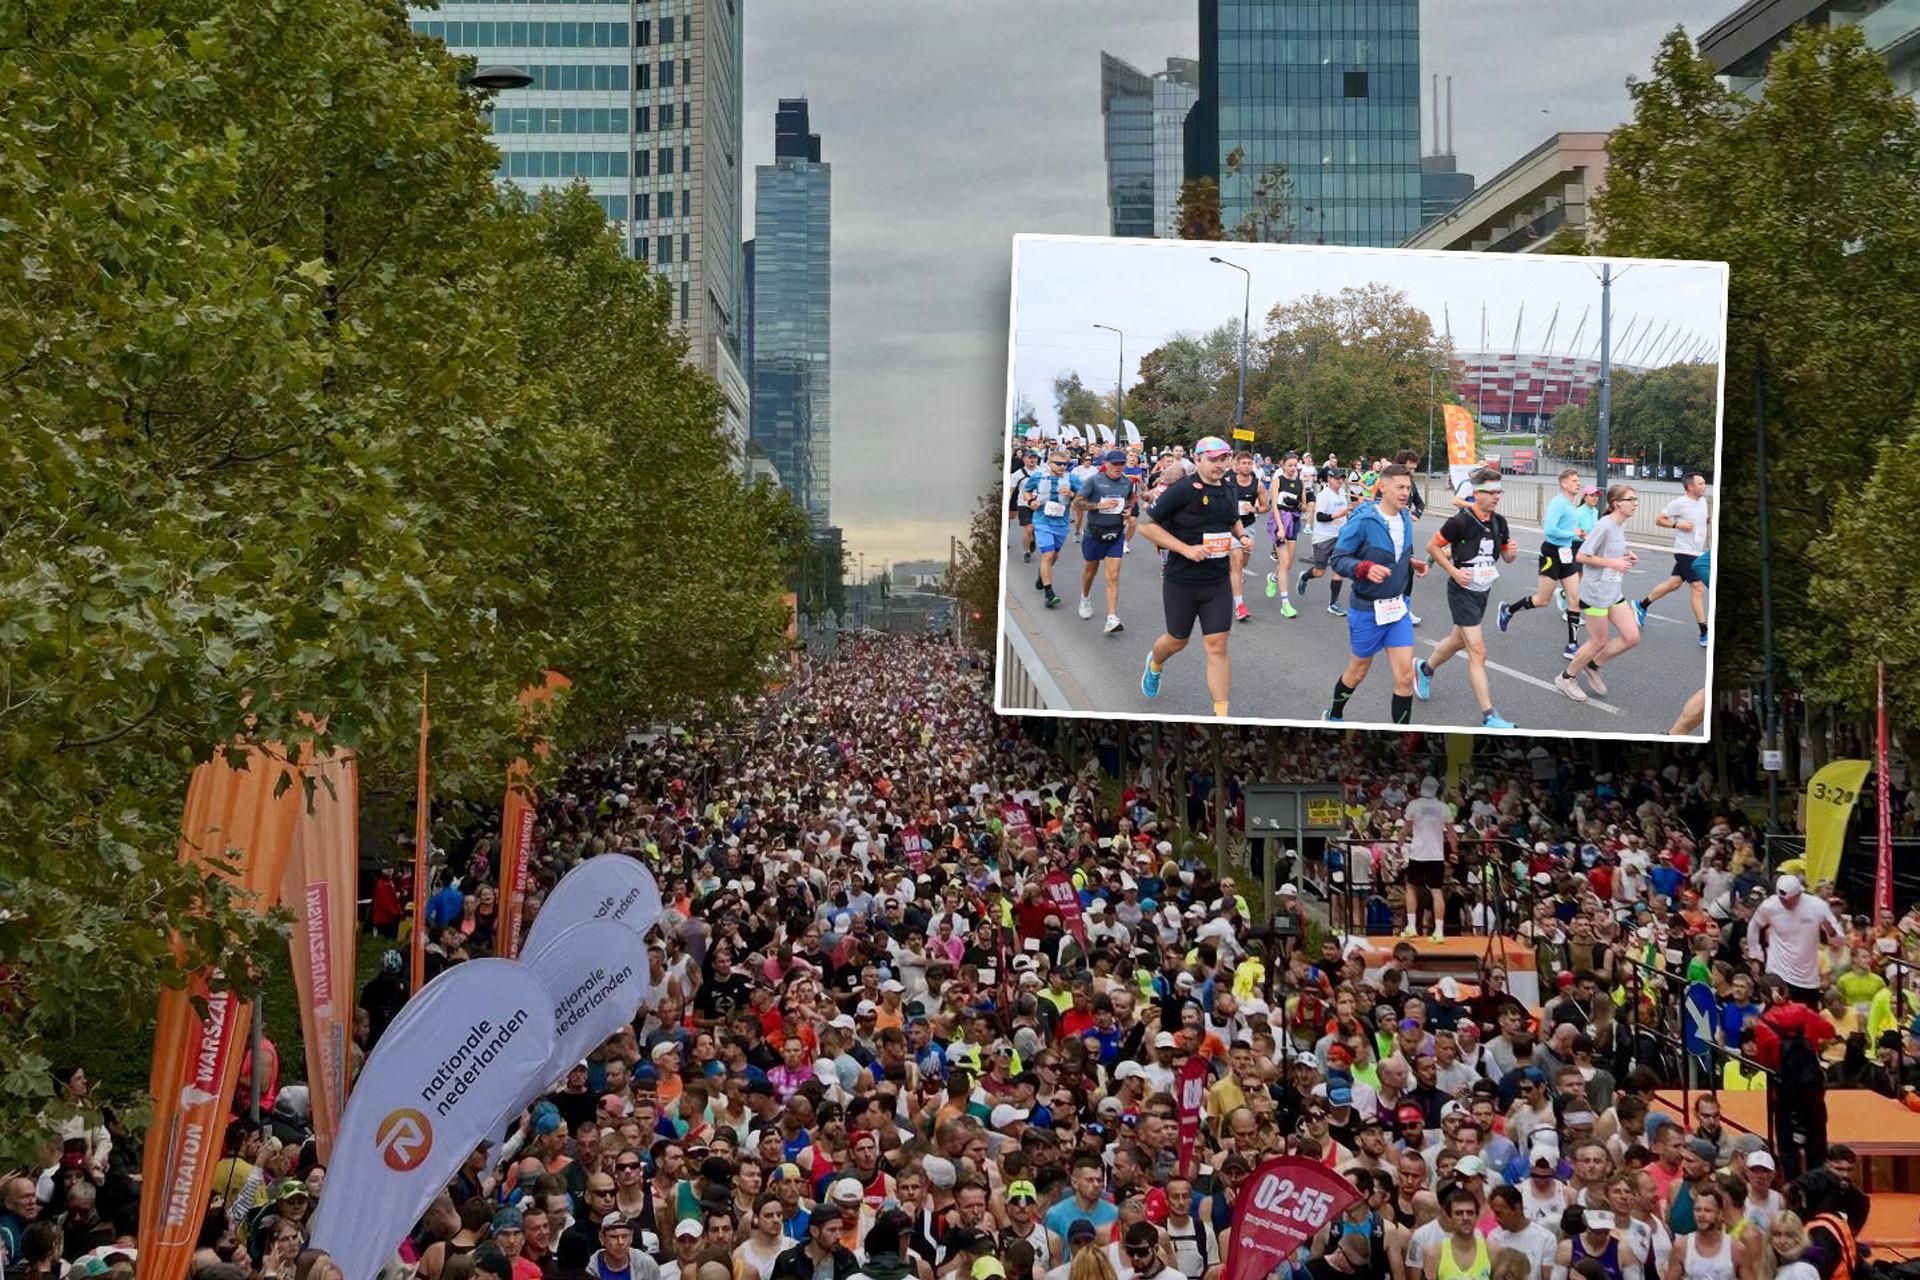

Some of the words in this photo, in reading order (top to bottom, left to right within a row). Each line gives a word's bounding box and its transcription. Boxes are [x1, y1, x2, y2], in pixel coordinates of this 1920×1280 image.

[421, 1020, 492, 1102] nationale
[437, 1009, 528, 1117] nederlanden
[167, 1123, 203, 1226] MARATON
[1254, 1174, 1335, 1227] 02:55
